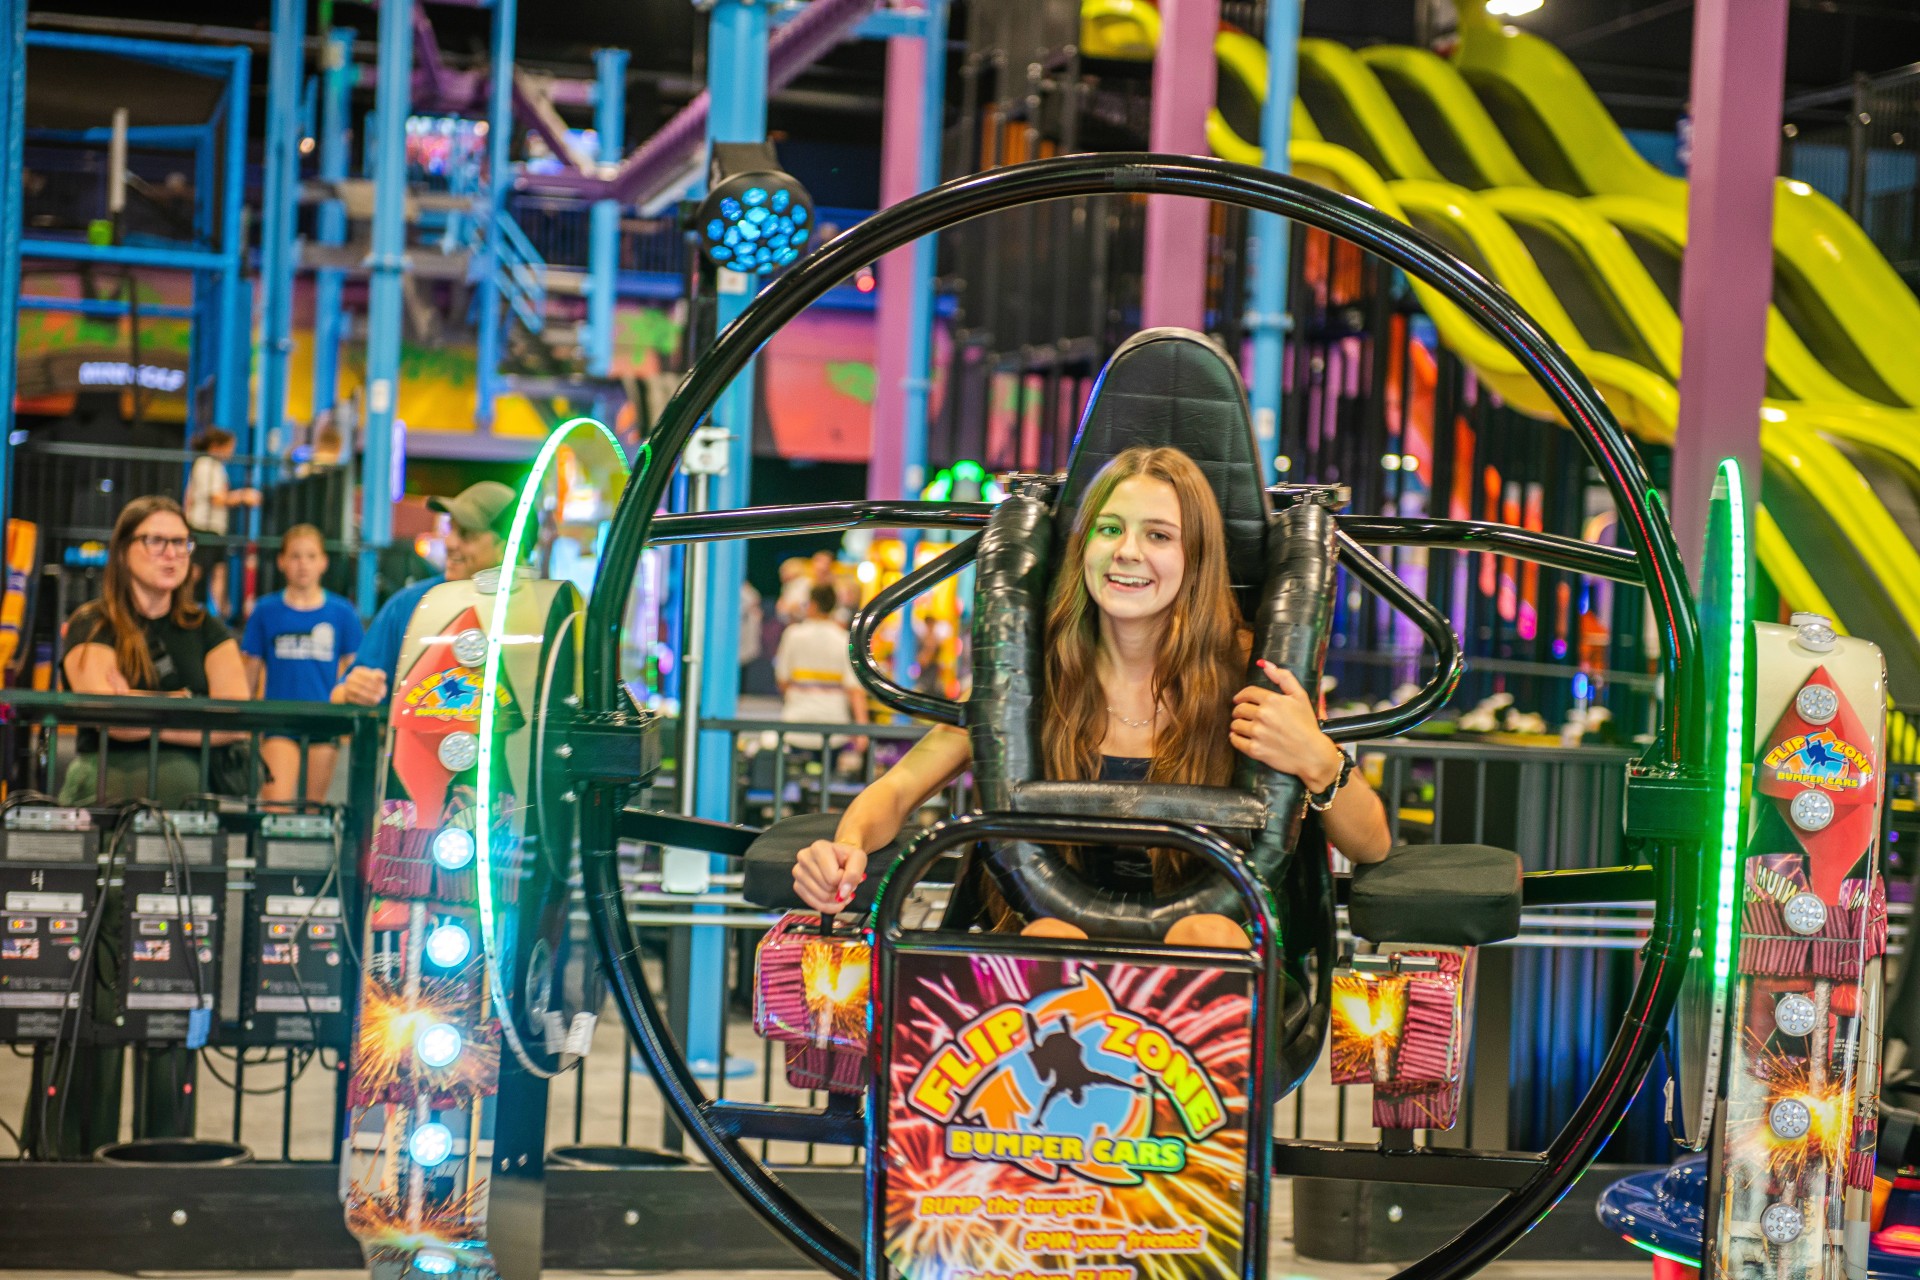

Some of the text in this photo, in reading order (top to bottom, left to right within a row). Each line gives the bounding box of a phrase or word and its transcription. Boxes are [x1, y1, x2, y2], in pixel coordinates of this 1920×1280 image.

[1764, 736, 1873, 775] FLIP ZONE
[1777, 772, 1858, 787] BUMPER CARS
[914, 1006, 1220, 1134] FLIP ZONE
[950, 1130, 1184, 1169] BUMPER CARS
[919, 1194, 1098, 1219] BUMP the target!
[1023, 1229, 1202, 1255] SPIN your friends!
